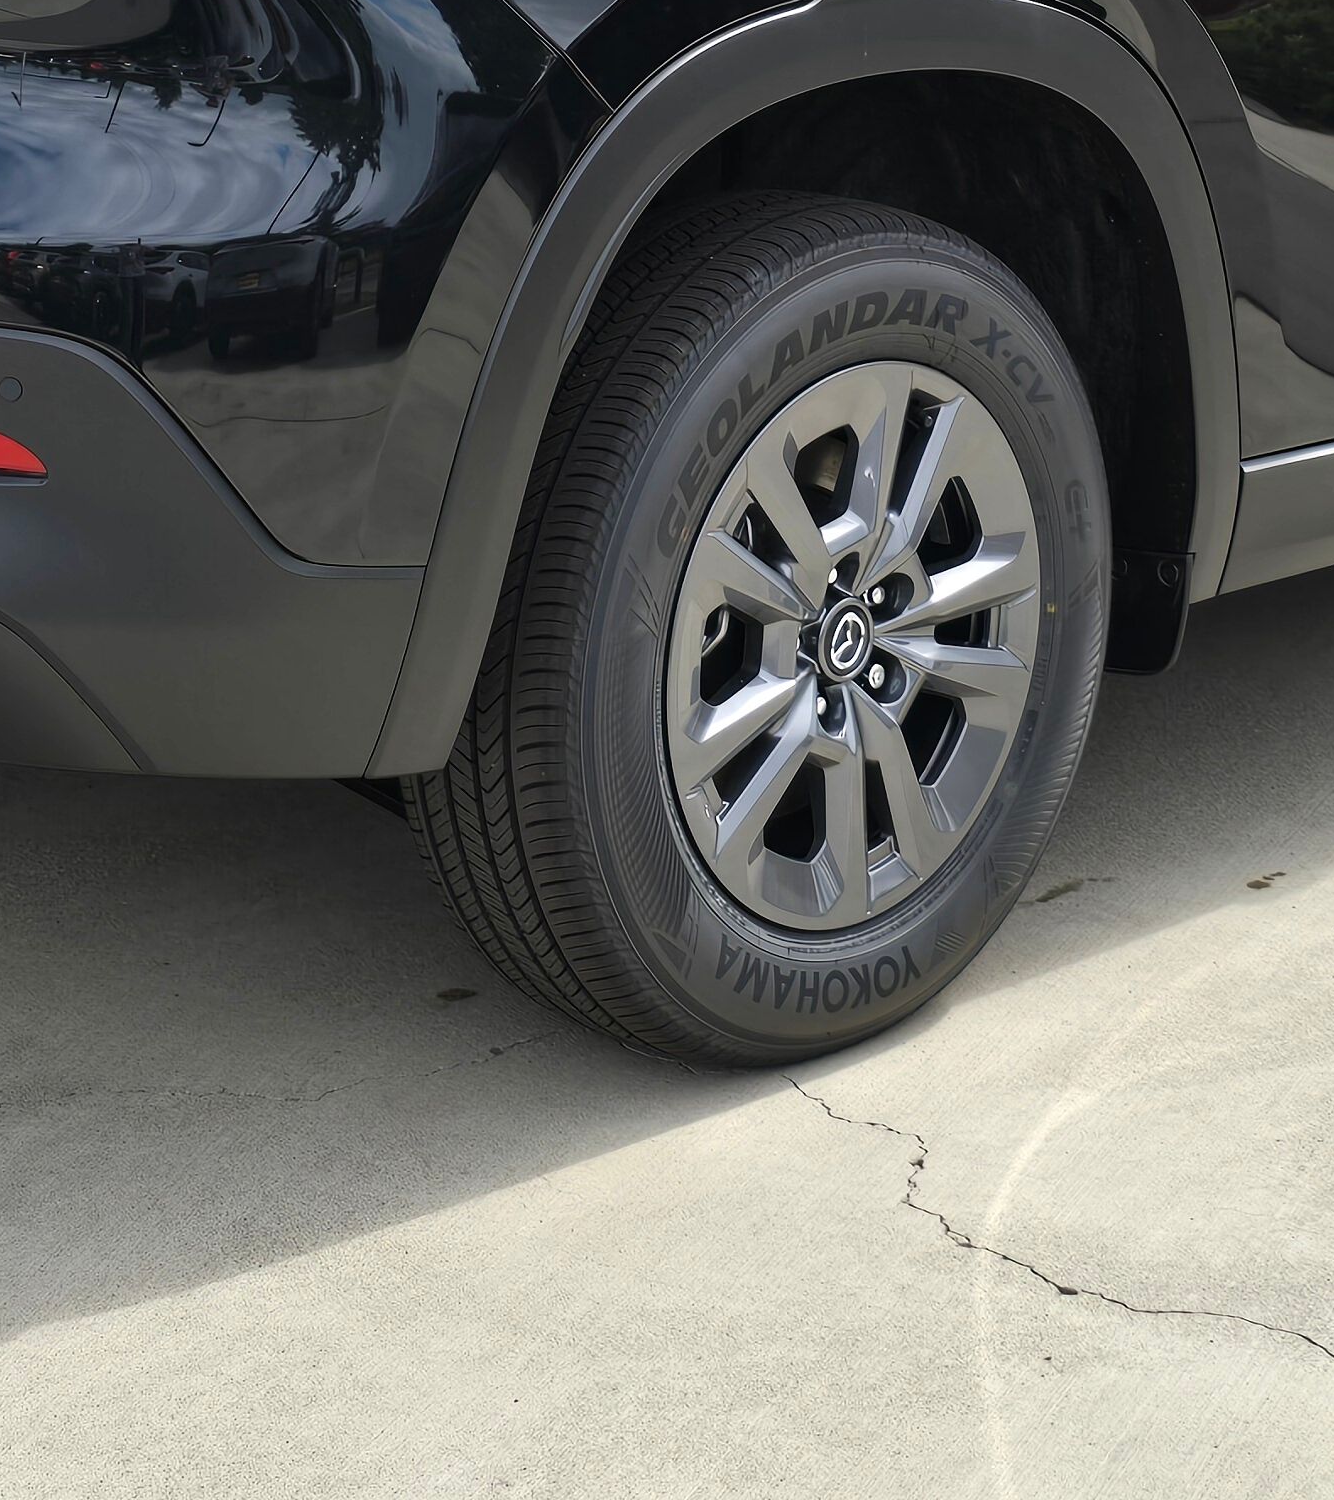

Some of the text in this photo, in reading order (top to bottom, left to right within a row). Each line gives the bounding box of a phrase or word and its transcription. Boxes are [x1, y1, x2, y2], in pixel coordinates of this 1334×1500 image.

[656, 288, 1055, 558] GEOLANDAR X-CV
[715, 932, 921, 1014] YOKOHAMA
